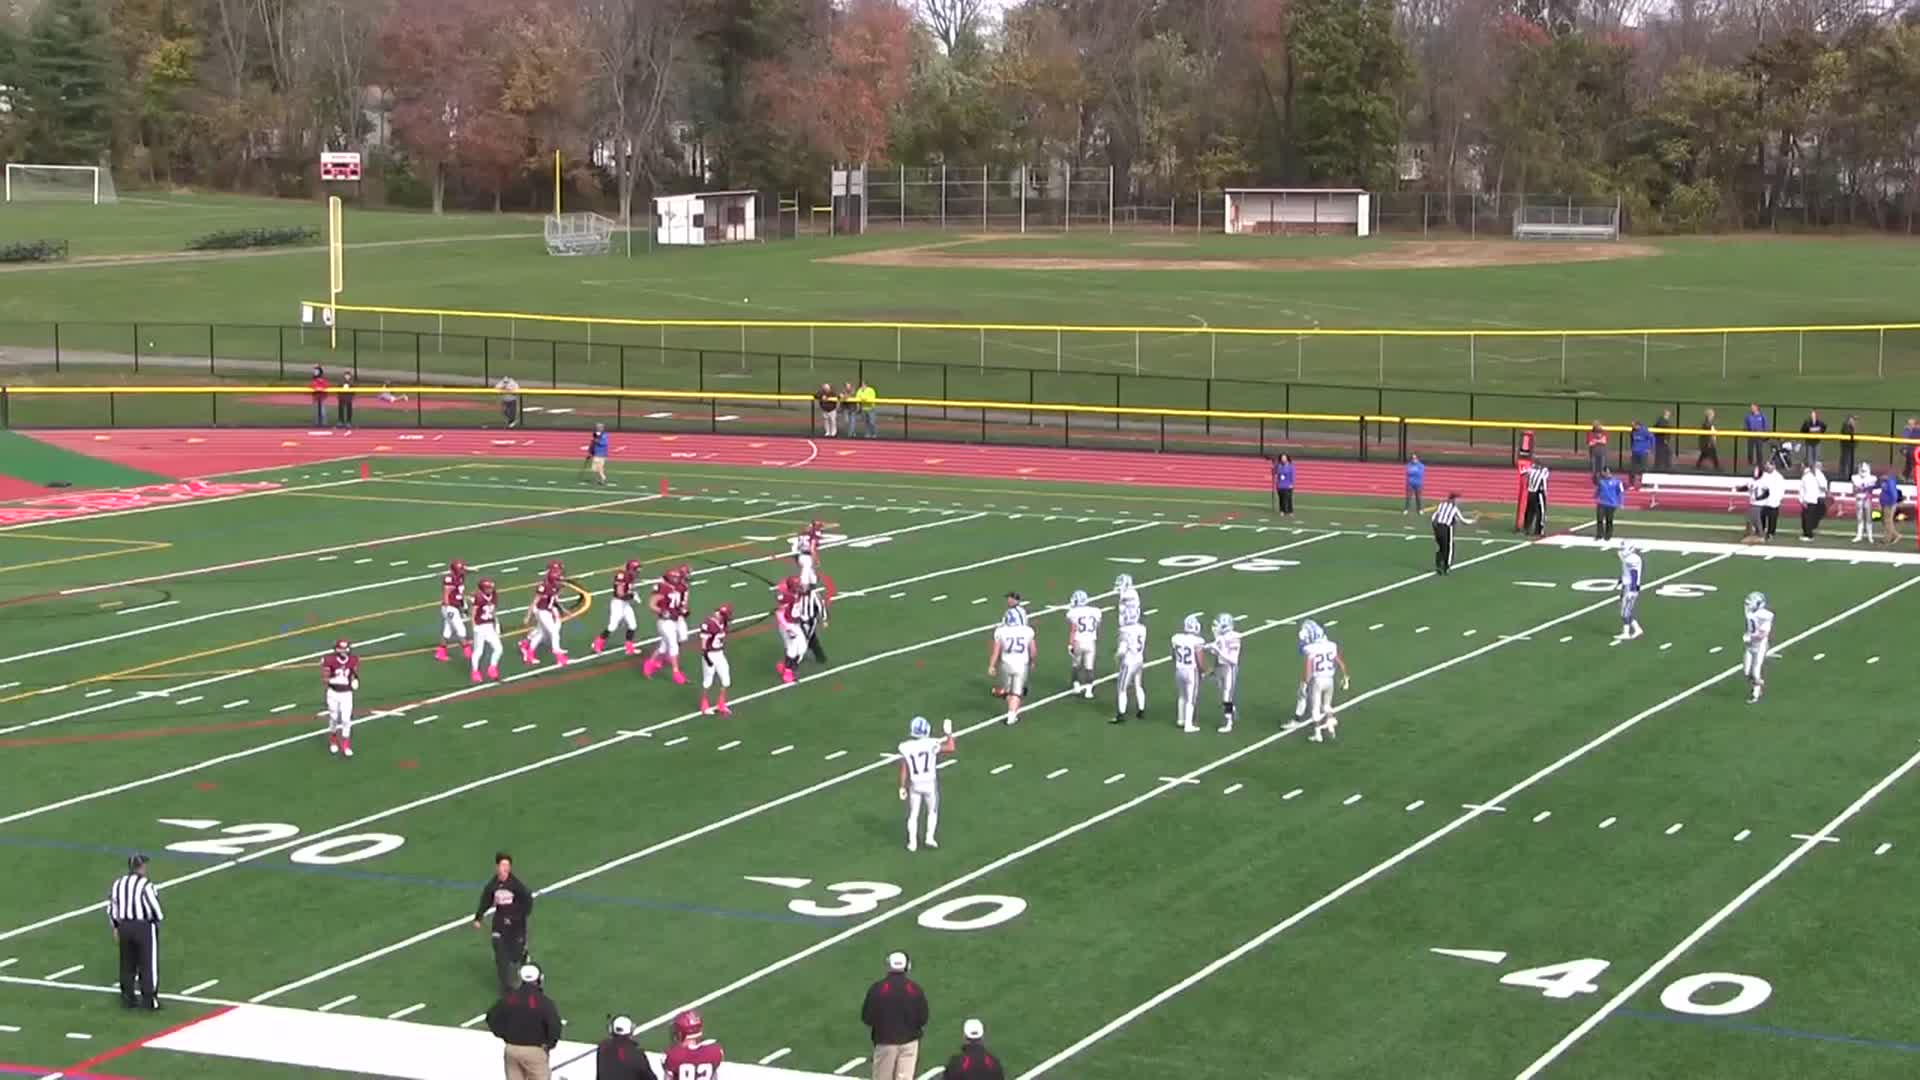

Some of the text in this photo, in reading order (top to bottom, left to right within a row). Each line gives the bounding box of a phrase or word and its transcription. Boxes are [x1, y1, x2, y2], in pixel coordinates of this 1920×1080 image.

[1077, 615, 1098, 634] 53
[1005, 636, 1026, 654] 75
[908, 751, 930, 775] 17
[163, 822, 406, 866] 20
[787, 880, 1028, 931] 30
[1498, 957, 1774, 1016] 40
